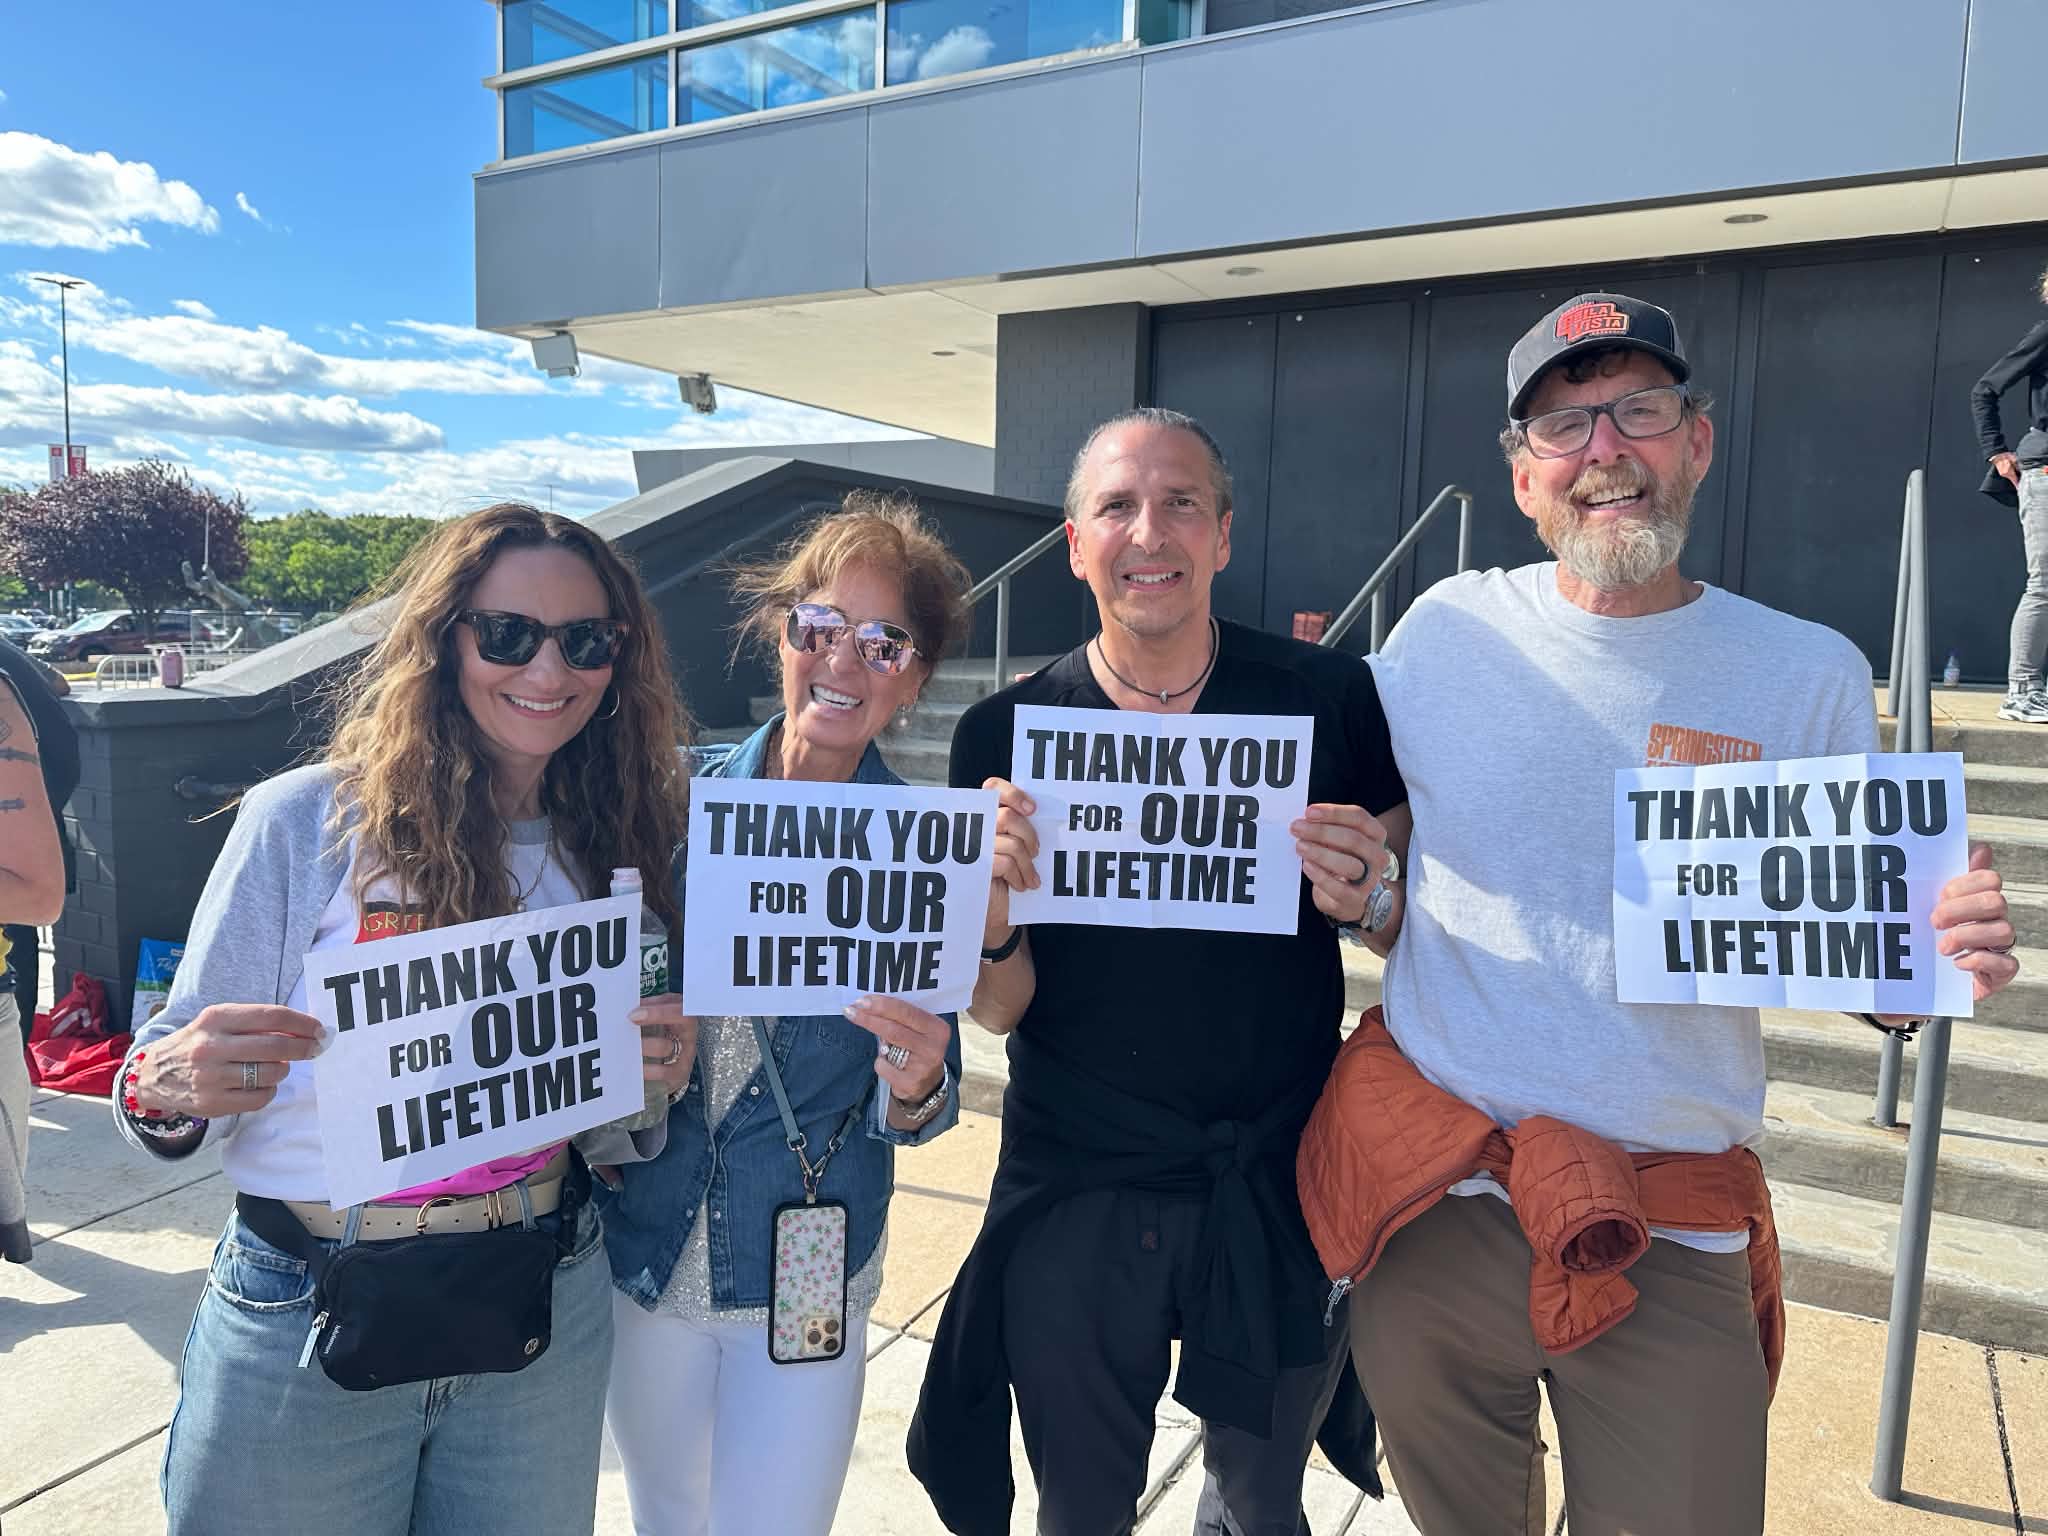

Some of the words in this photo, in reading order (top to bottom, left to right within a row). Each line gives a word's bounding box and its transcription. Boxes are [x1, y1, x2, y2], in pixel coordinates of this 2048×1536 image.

[1026, 728, 1188, 787] THANK
[1198, 737, 1298, 789] YOU
[1647, 722, 1763, 765] SPRINGSTEEN
[703, 801, 875, 862] THANK
[885, 809, 985, 865] YOU
[1068, 803, 1123, 832] FOR
[1140, 792, 1260, 850] OUR
[1627, 783, 1812, 842] THANK
[1823, 778, 1948, 837] YOU
[749, 881, 807, 915] FOR
[826, 865, 947, 934] OUR
[1052, 850, 1257, 905] LIFETIME
[1677, 863, 1738, 897] FOR
[1760, 844, 1908, 913] OUR
[323, 938, 518, 1033] THANK
[526, 916, 628, 985] YOU
[732, 935, 944, 994] LIFETIME
[1663, 919, 1913, 981] LIFETIME
[389, 1033, 453, 1079] FOR
[471, 982, 599, 1069] OUR
[376, 1047, 603, 1163] LIFETIME
